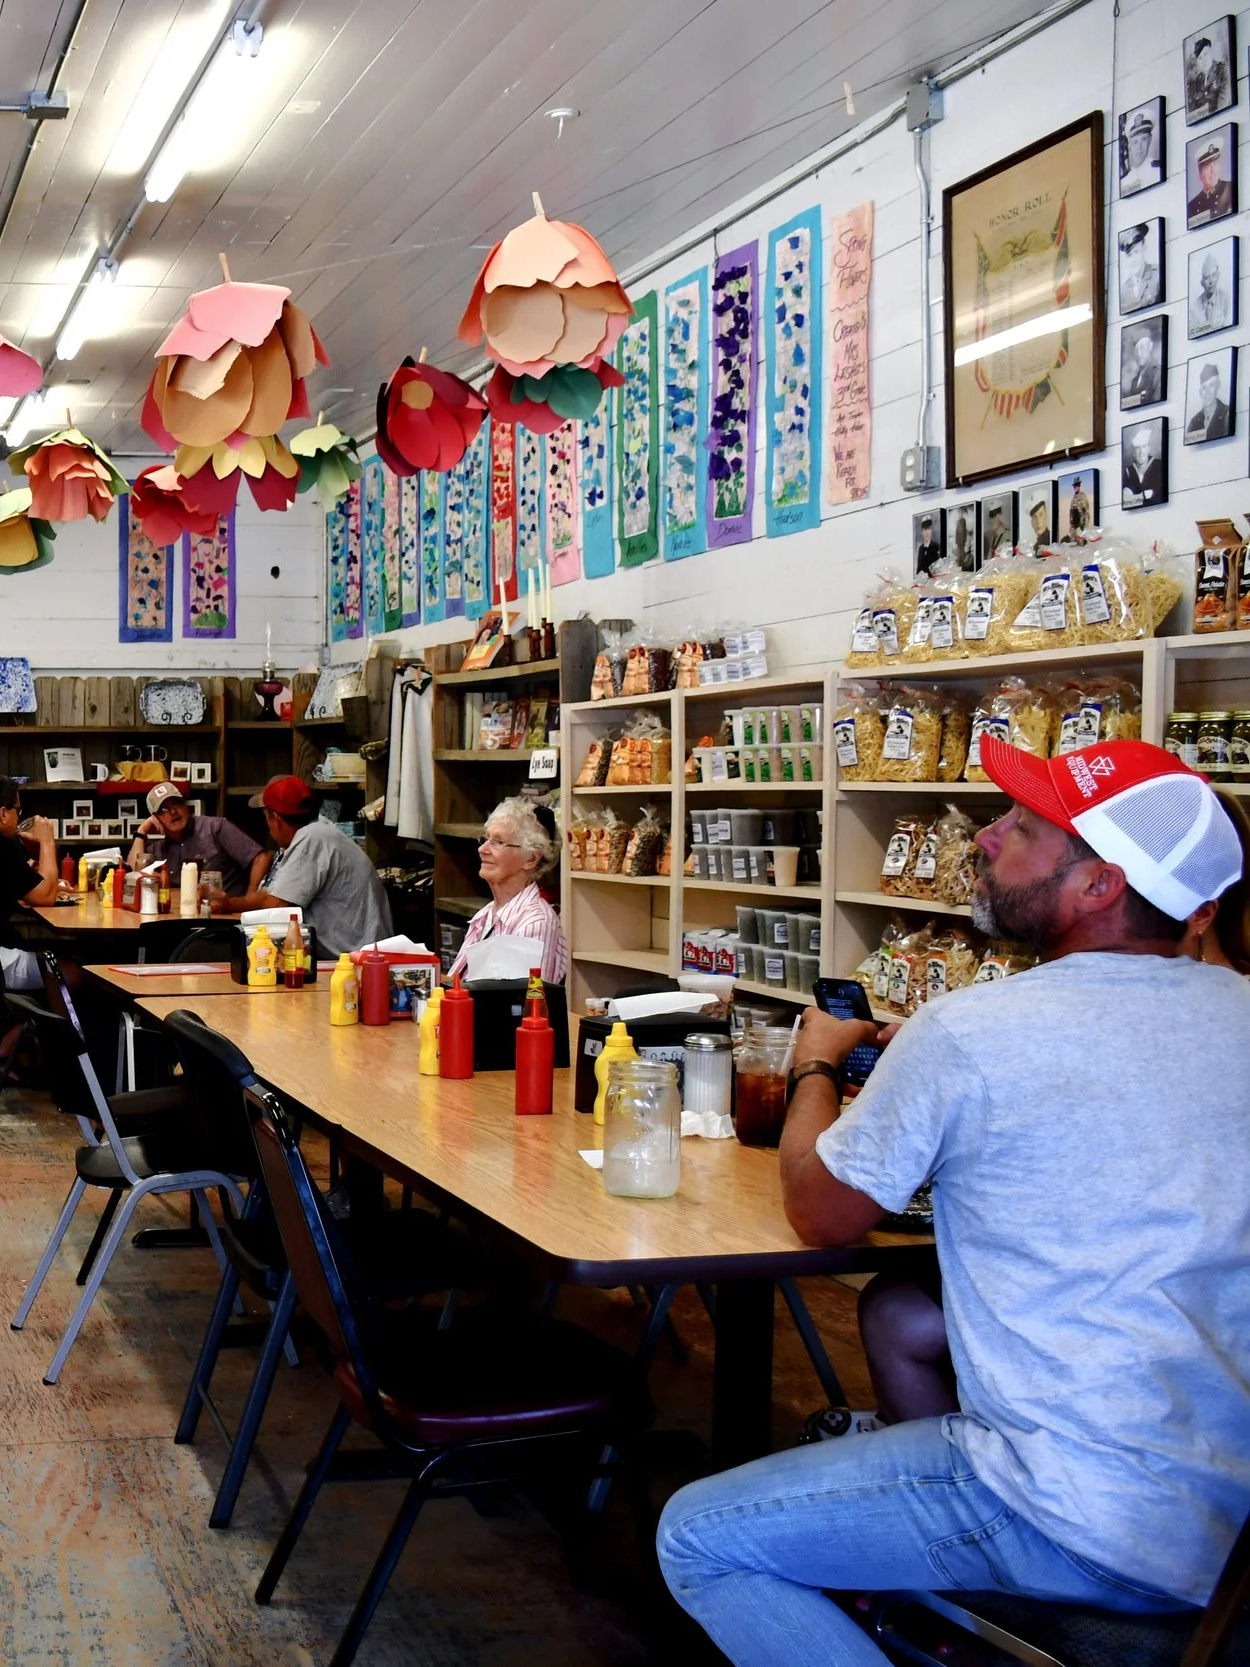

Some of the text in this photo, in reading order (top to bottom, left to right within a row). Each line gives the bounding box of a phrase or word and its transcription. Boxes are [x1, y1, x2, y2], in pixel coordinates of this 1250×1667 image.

[989, 193, 1052, 229] HONOR ROLL
[532, 756, 554, 773] Lye Soap
[1066, 756, 1092, 798] EQUIPMENT
[1075, 755, 1098, 790] MIDWEST
